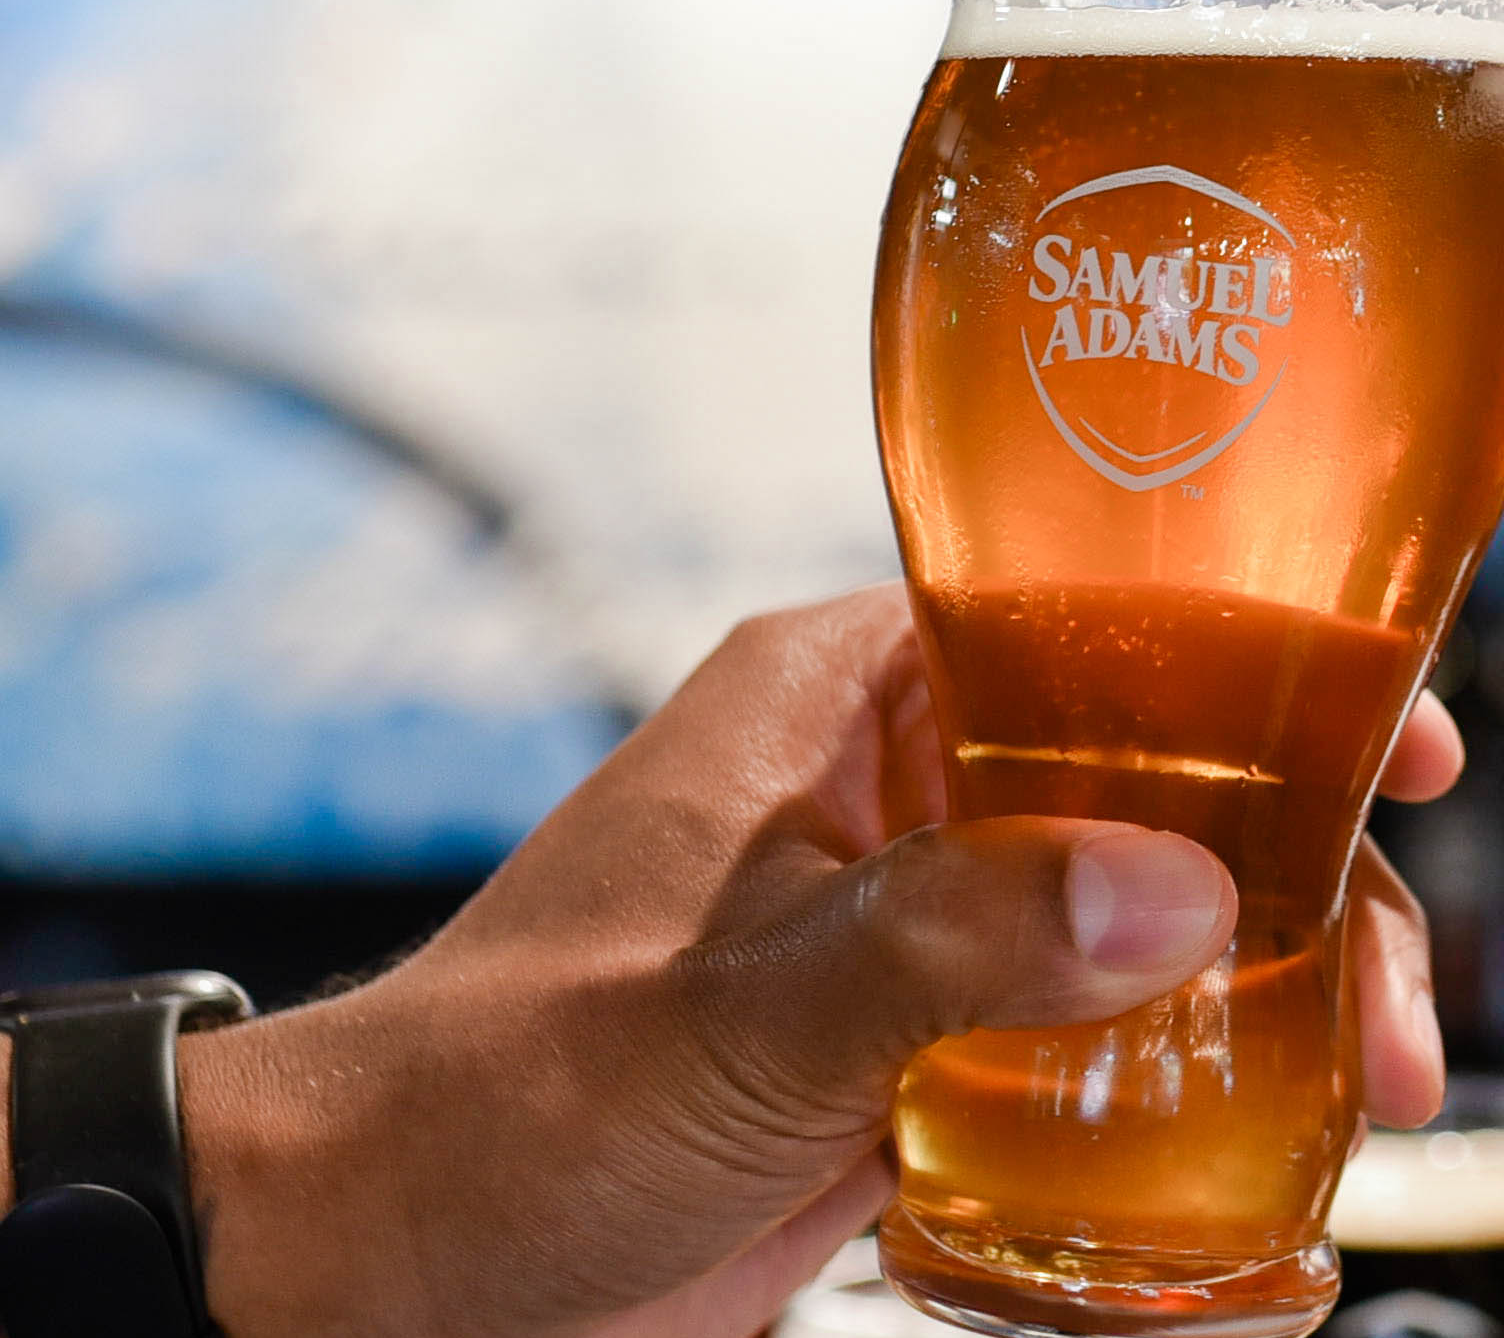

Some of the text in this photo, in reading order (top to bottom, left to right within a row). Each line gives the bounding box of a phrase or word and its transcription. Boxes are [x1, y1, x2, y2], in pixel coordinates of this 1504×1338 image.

[1028, 234, 1293, 327] SAMUEL
[1039, 304, 1261, 387] ADAMS
[1180, 484, 1206, 501] TM
